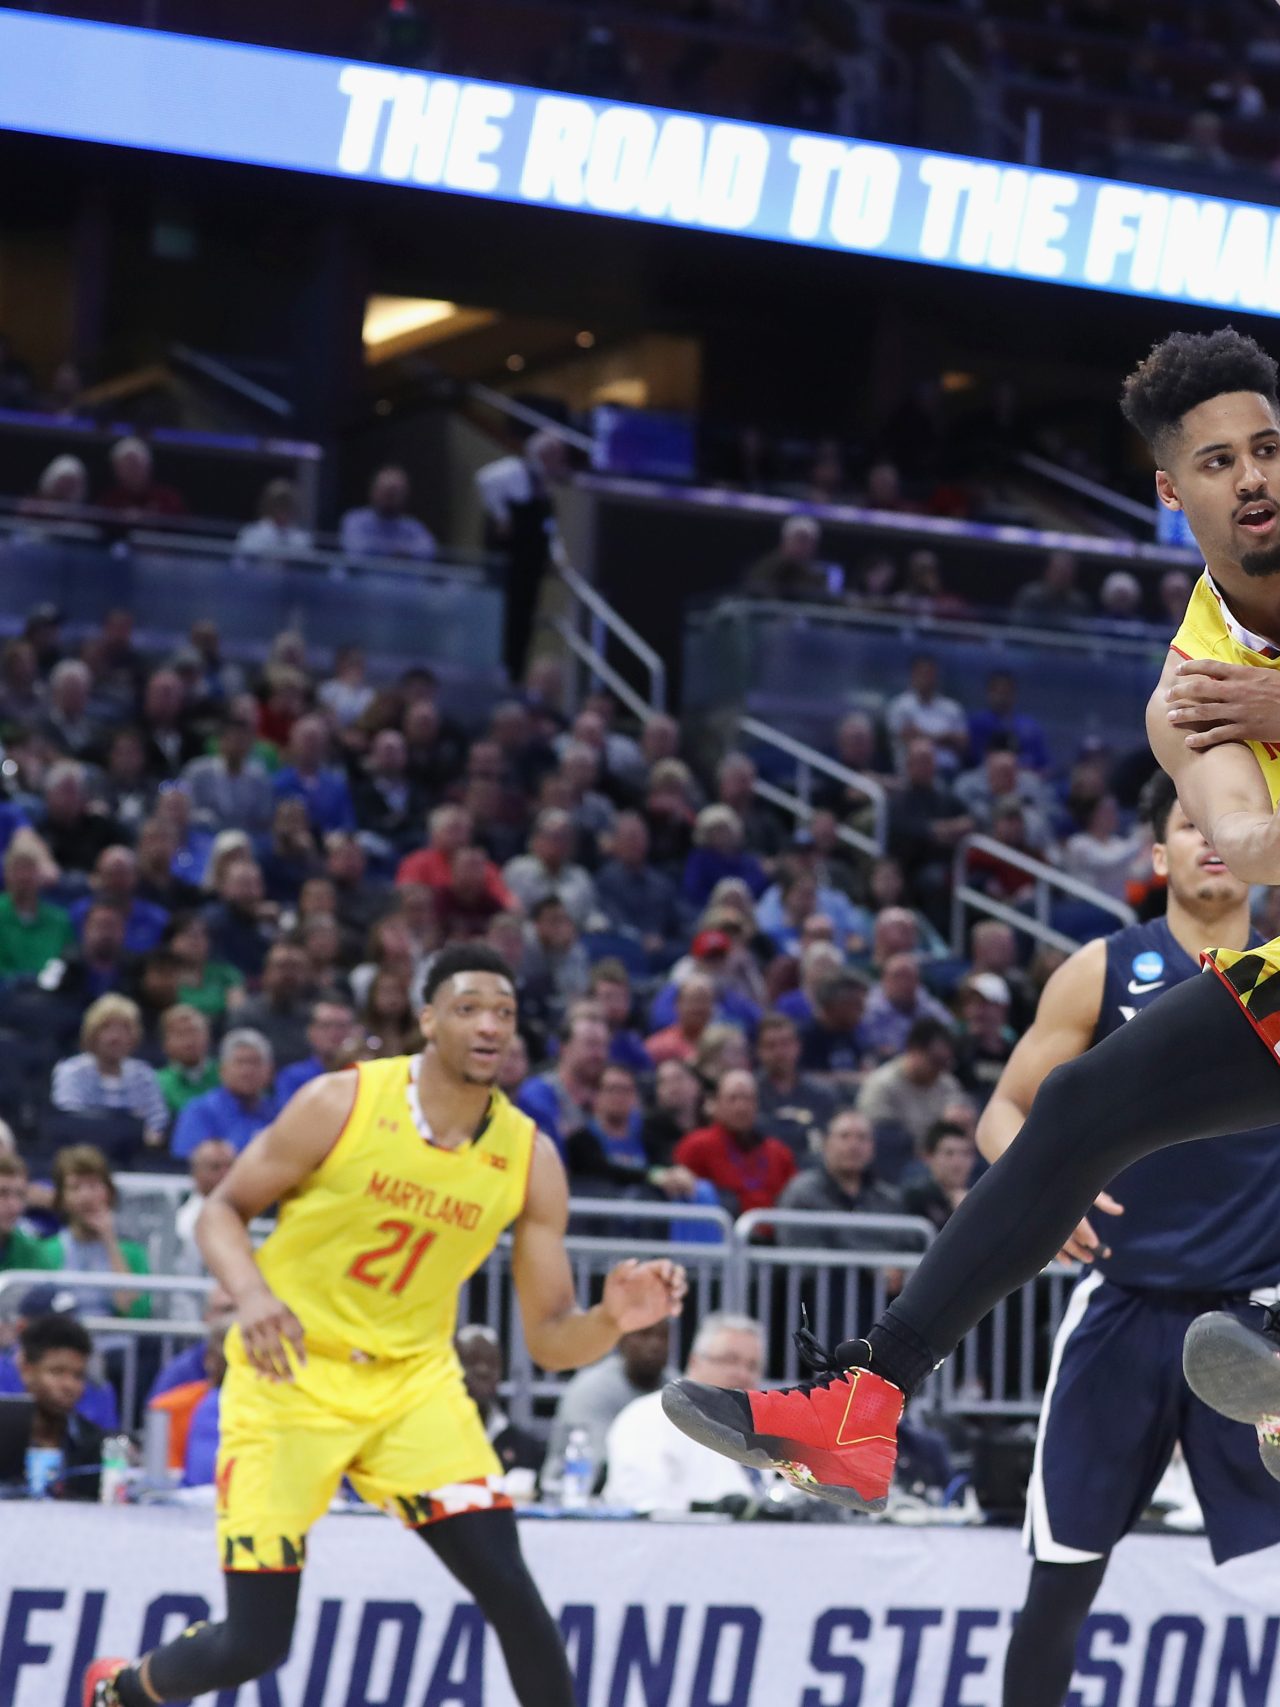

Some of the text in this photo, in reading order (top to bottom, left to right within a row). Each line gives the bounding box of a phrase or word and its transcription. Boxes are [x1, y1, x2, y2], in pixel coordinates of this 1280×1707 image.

[337, 65, 514, 192] THE
[519, 95, 770, 230] ROAD
[788, 134, 901, 250] TO
[918, 158, 1080, 277] THE
[365, 1171, 484, 1231] MARYLAND
[346, 1219, 438, 1295] 21
